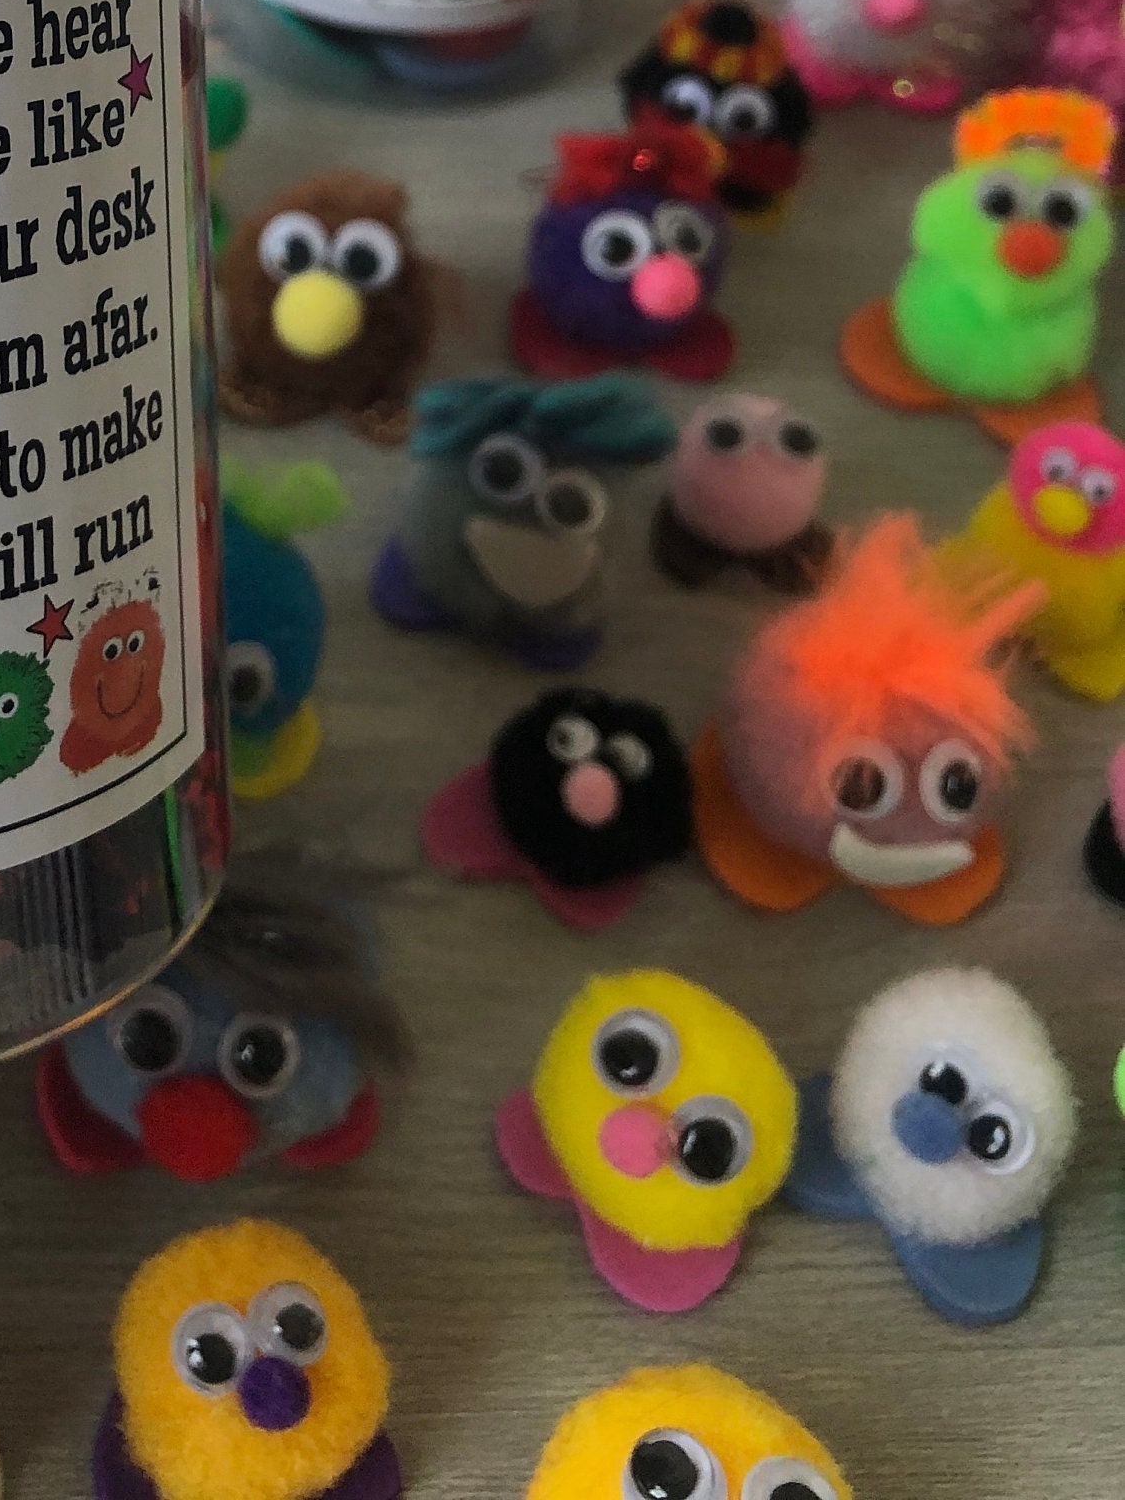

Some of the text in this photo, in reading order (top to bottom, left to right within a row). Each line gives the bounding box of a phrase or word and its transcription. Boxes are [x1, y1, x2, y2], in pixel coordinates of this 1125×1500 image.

[28, 89, 126, 170] like
[54, 167, 157, 269] desk
[61, 284, 159, 378] afar.
[59, 384, 165, 480] make
[72, 492, 154, 575] run
